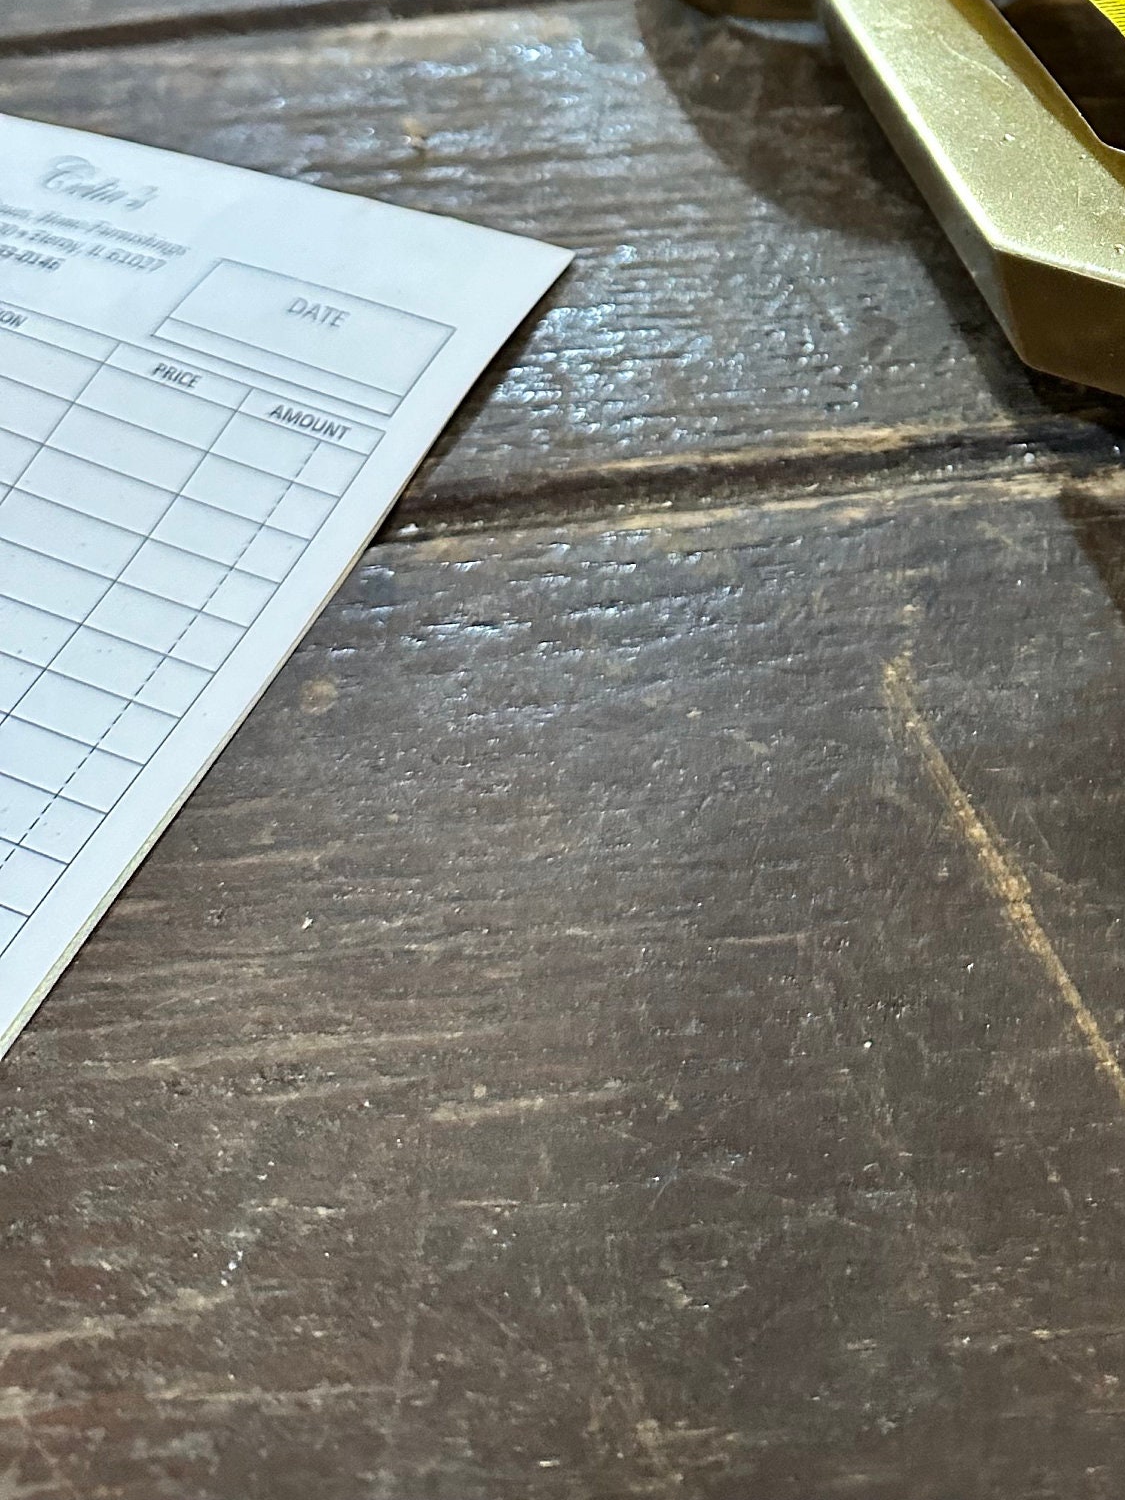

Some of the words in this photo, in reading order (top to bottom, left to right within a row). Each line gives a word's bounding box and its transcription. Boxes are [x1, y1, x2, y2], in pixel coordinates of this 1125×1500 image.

[287, 297, 350, 328] DATE
[152, 362, 202, 389] PRICE
[268, 404, 352, 440] AMOUNT
